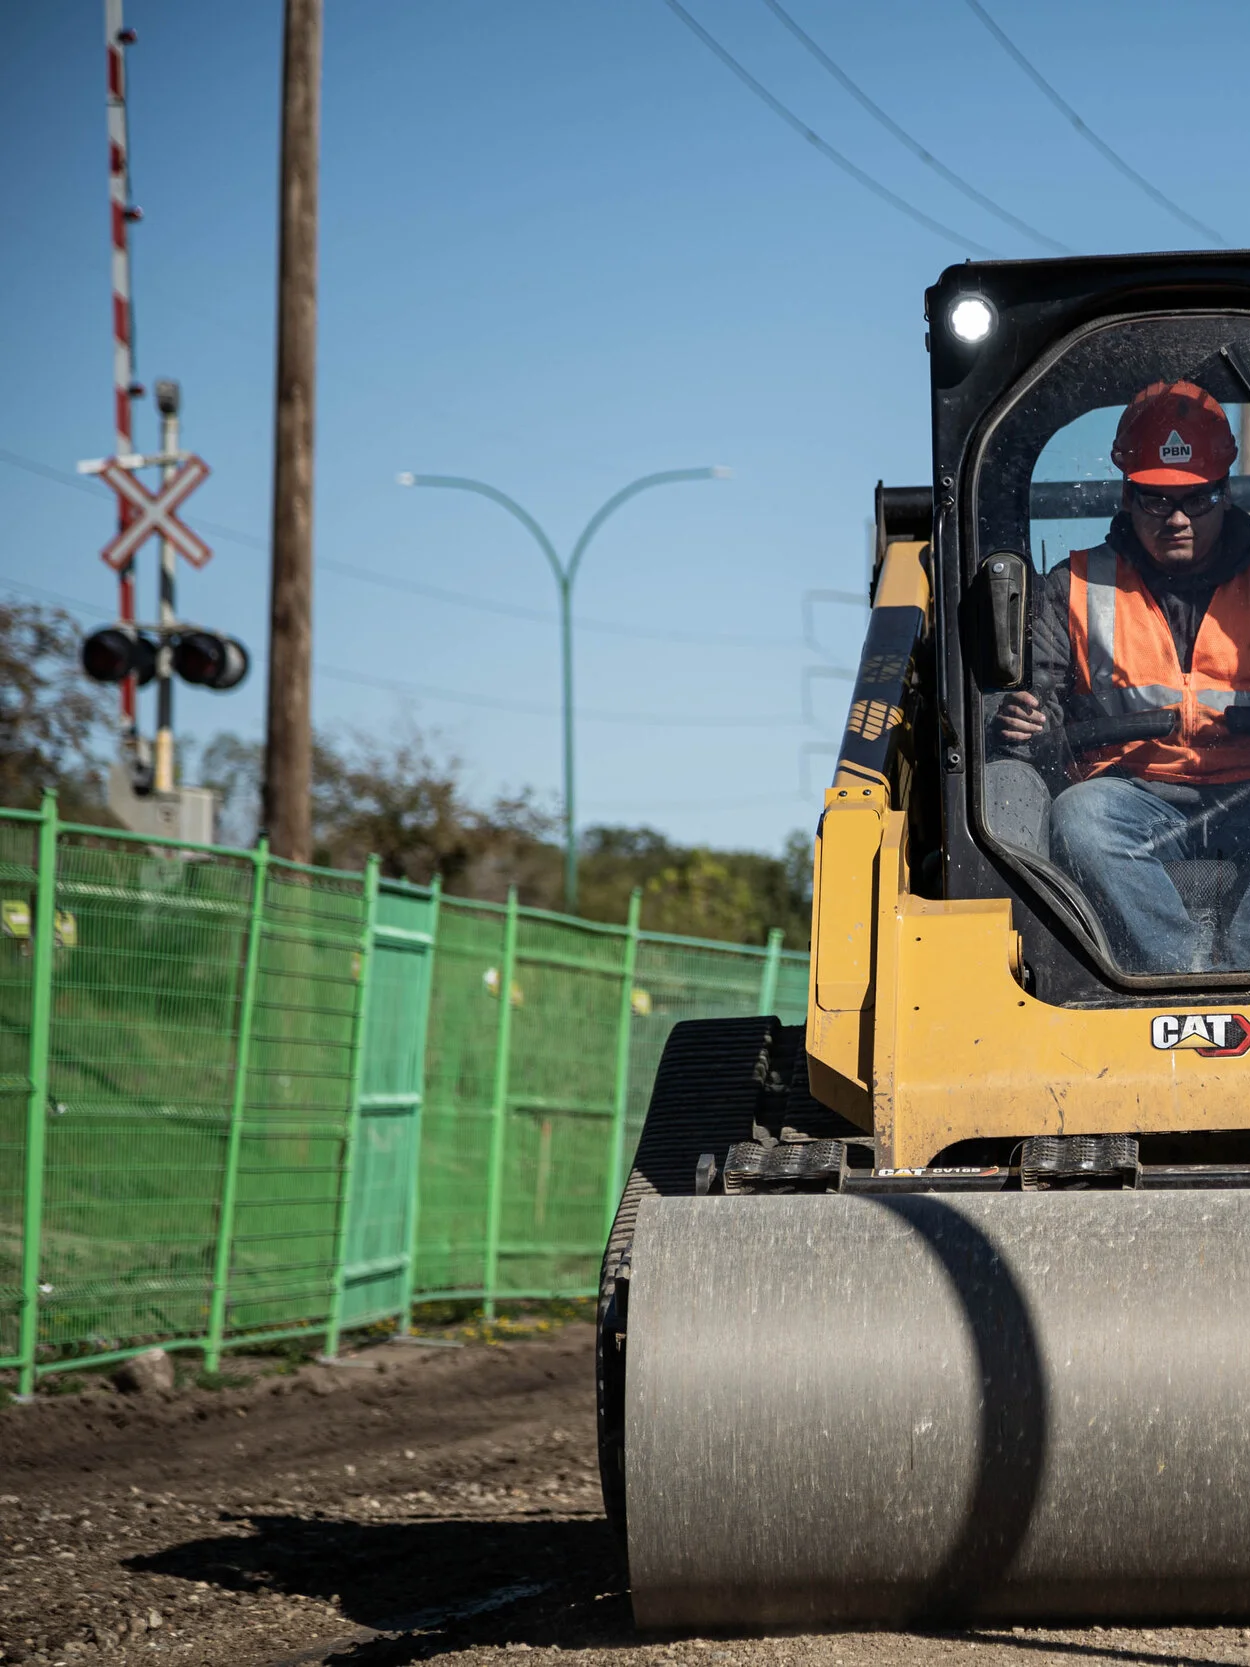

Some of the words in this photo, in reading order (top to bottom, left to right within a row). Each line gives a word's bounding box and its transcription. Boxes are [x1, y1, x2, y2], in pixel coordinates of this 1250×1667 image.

[1162, 446, 1190, 456] PBN
[1152, 1014, 1232, 1049] CAT
[878, 1168, 926, 1176] CAT
